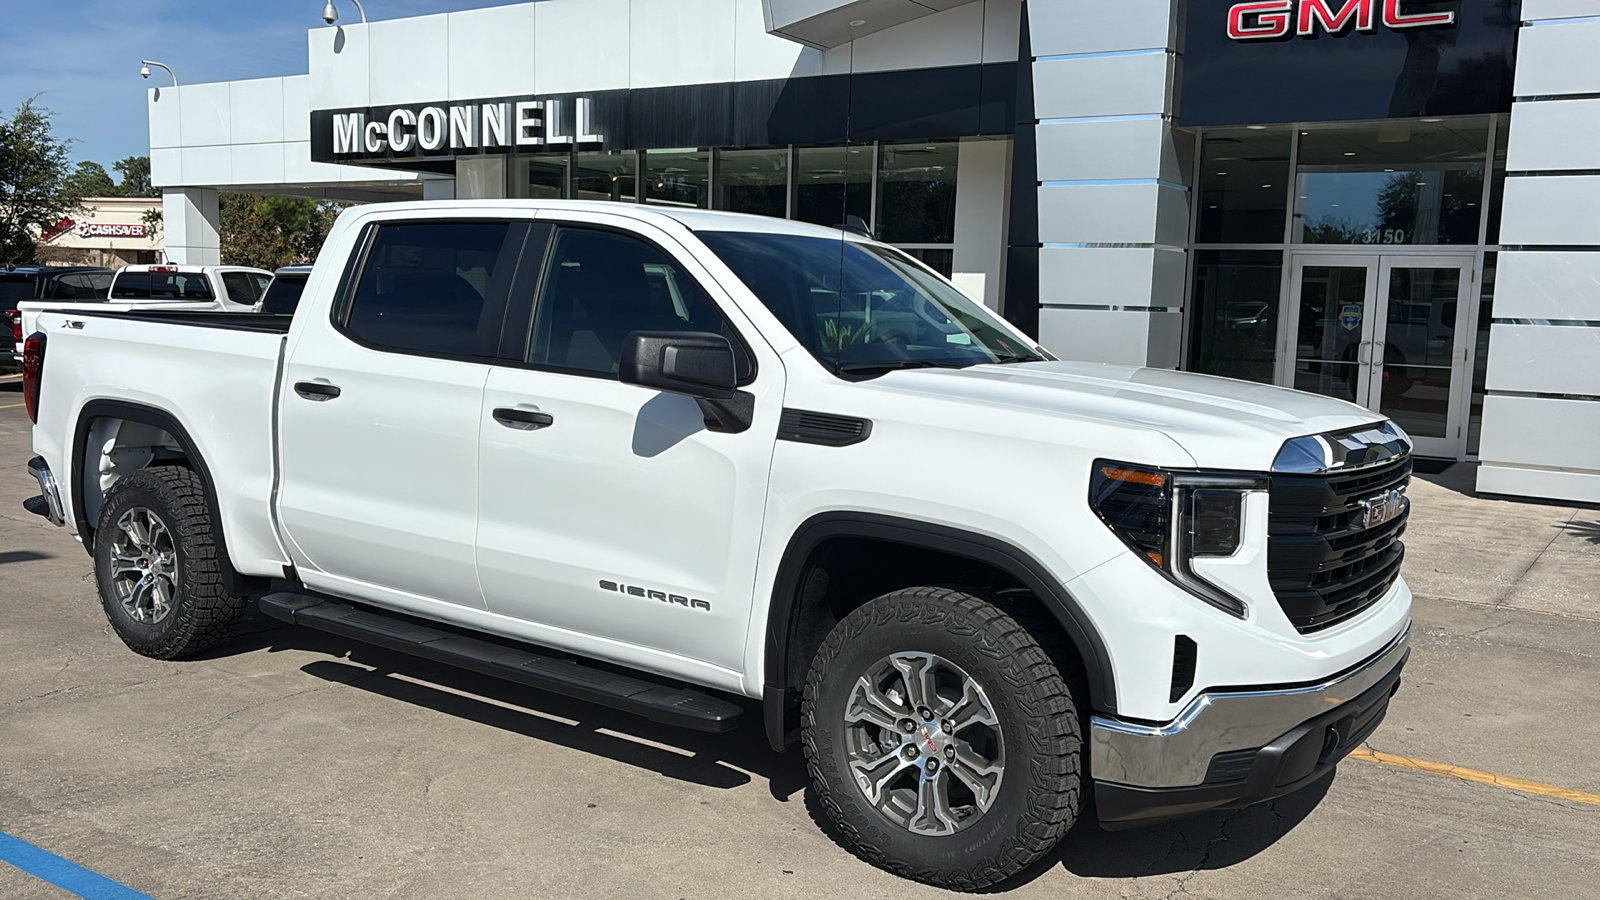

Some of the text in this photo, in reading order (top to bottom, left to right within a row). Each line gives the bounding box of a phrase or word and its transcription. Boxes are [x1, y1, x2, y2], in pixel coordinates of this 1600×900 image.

[1226, 0, 1455, 40] GMC
[332, 97, 604, 154] McCONNELL
[1361, 228, 1405, 244] 3150
[599, 579, 711, 611] SIERRA
